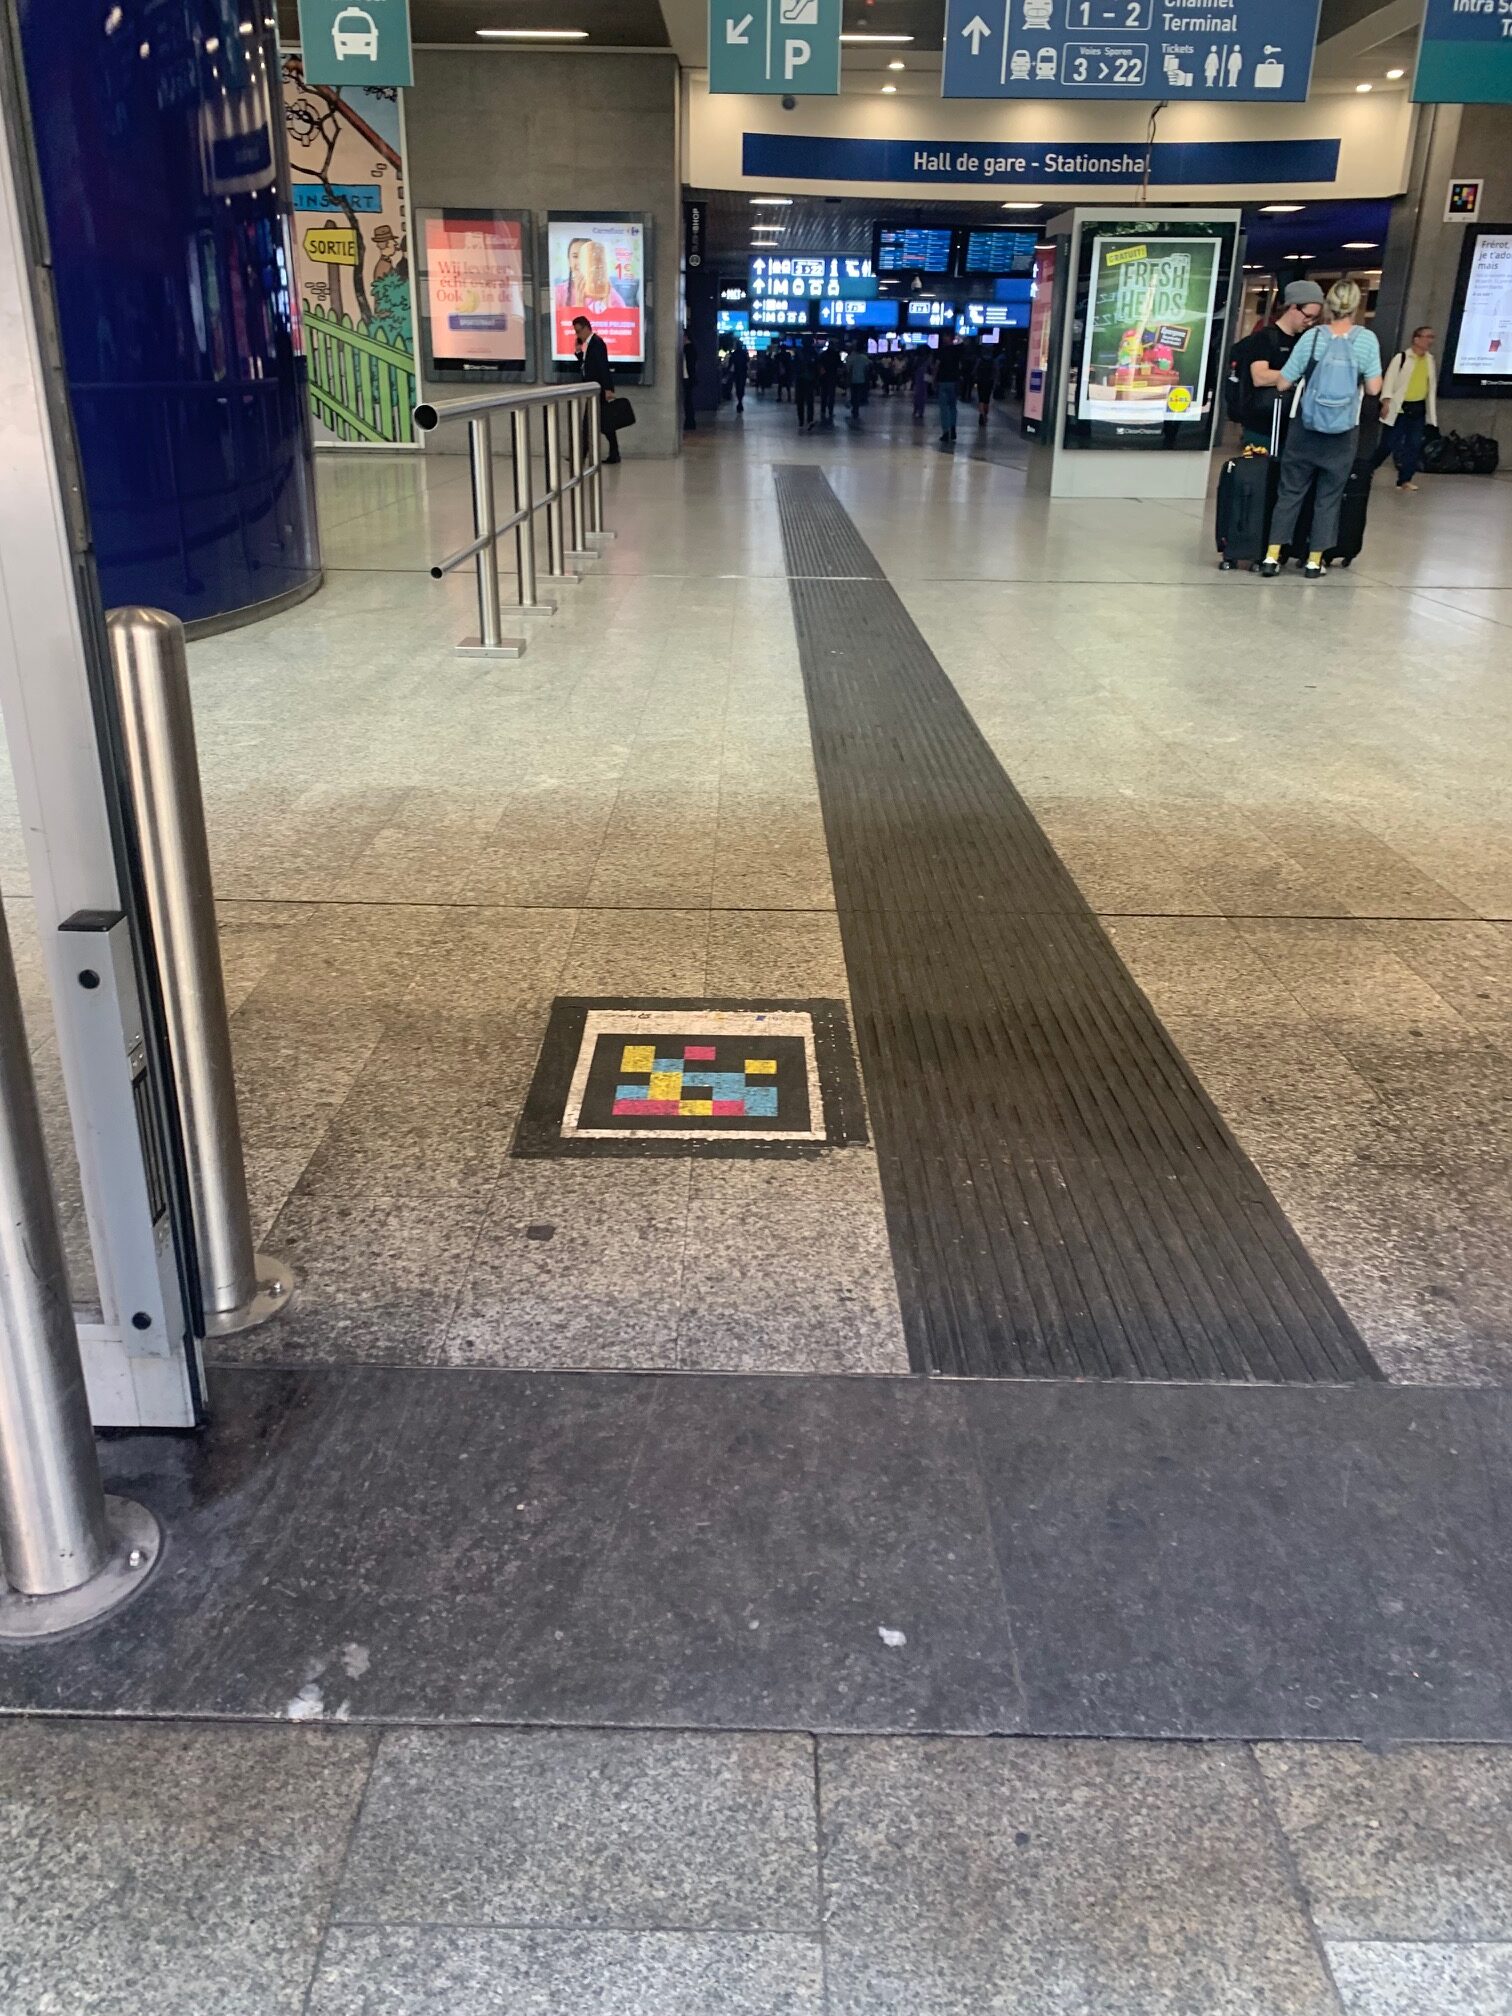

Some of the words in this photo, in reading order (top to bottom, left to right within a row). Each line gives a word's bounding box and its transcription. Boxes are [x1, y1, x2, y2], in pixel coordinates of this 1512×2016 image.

[1080, 1, 1091, 26] 1
[1125, 2, 1141, 26] 2
[1162, 14, 1238, 32] Terminal
[1080, 46, 1101, 55] Voies
[1104, 47, 1133, 57] Sporen
[1161, 43, 1195, 54] Tickets
[784, 39, 812, 80] P
[1072, 57, 1088, 82] 3
[1113, 57, 1142, 82] 22
[914, 152, 951, 171] Hall
[956, 153, 979, 171] de
[984, 156, 1026, 176] gare
[309, 240, 355, 257] SORTIE
[438, 261, 461, 276] Wij
[437, 289, 463, 302] Ook
[1121, 289, 1183, 319] HEDS
